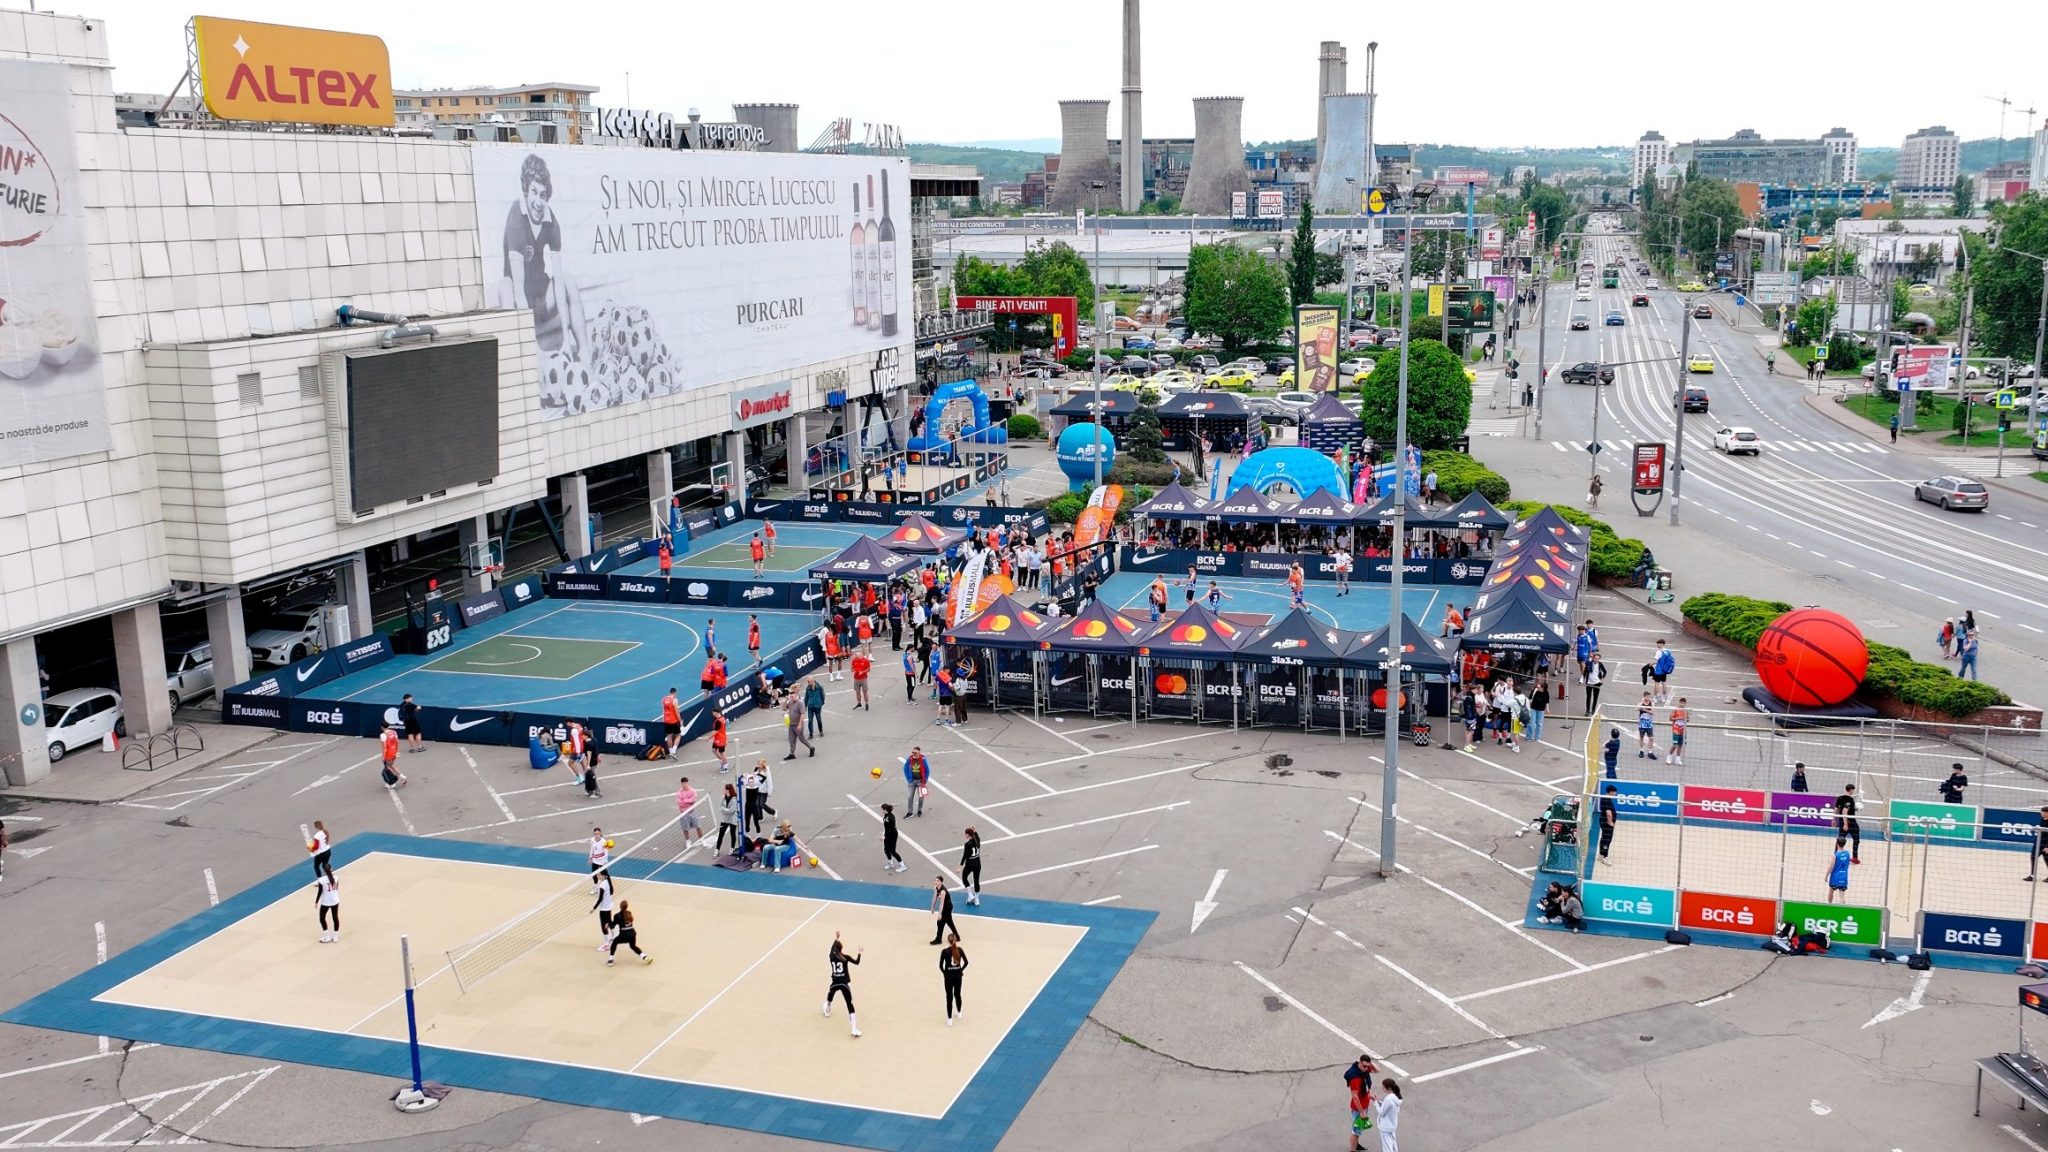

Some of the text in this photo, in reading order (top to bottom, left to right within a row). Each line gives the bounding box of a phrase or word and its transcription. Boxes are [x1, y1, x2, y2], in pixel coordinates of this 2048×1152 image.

[863, 122, 905, 149] ZARA
[627, 180, 672, 210] NOI,
[592, 215, 844, 254] AM TRECUT PROBA TIMPULUI.
[736, 297, 804, 325] PURCARI
[975, 300, 998, 310] BINE
[1018, 300, 1048, 311] VENIT!
[6, 427, 42, 438] noastră
[42, 424, 54, 433] de
[54, 420, 89, 433] produse
[1004, 514, 1022, 523] BCR
[1196, 555, 1215, 565] BCR
[1101, 679, 1124, 689] BCR
[1206, 685, 1230, 696] BCR
[1260, 684, 1283, 696] BCR
[1260, 695, 1286, 704] Leasing
[241, 706, 281, 719] IULIUSMALL
[306, 710, 330, 724] BCR
[605, 726, 647, 746] ROM
[1602, 898, 1634, 913] BCR
[1701, 907, 1735, 923] BCR
[1945, 929, 1981, 945] BCR
[831, 961, 844, 973] 13
